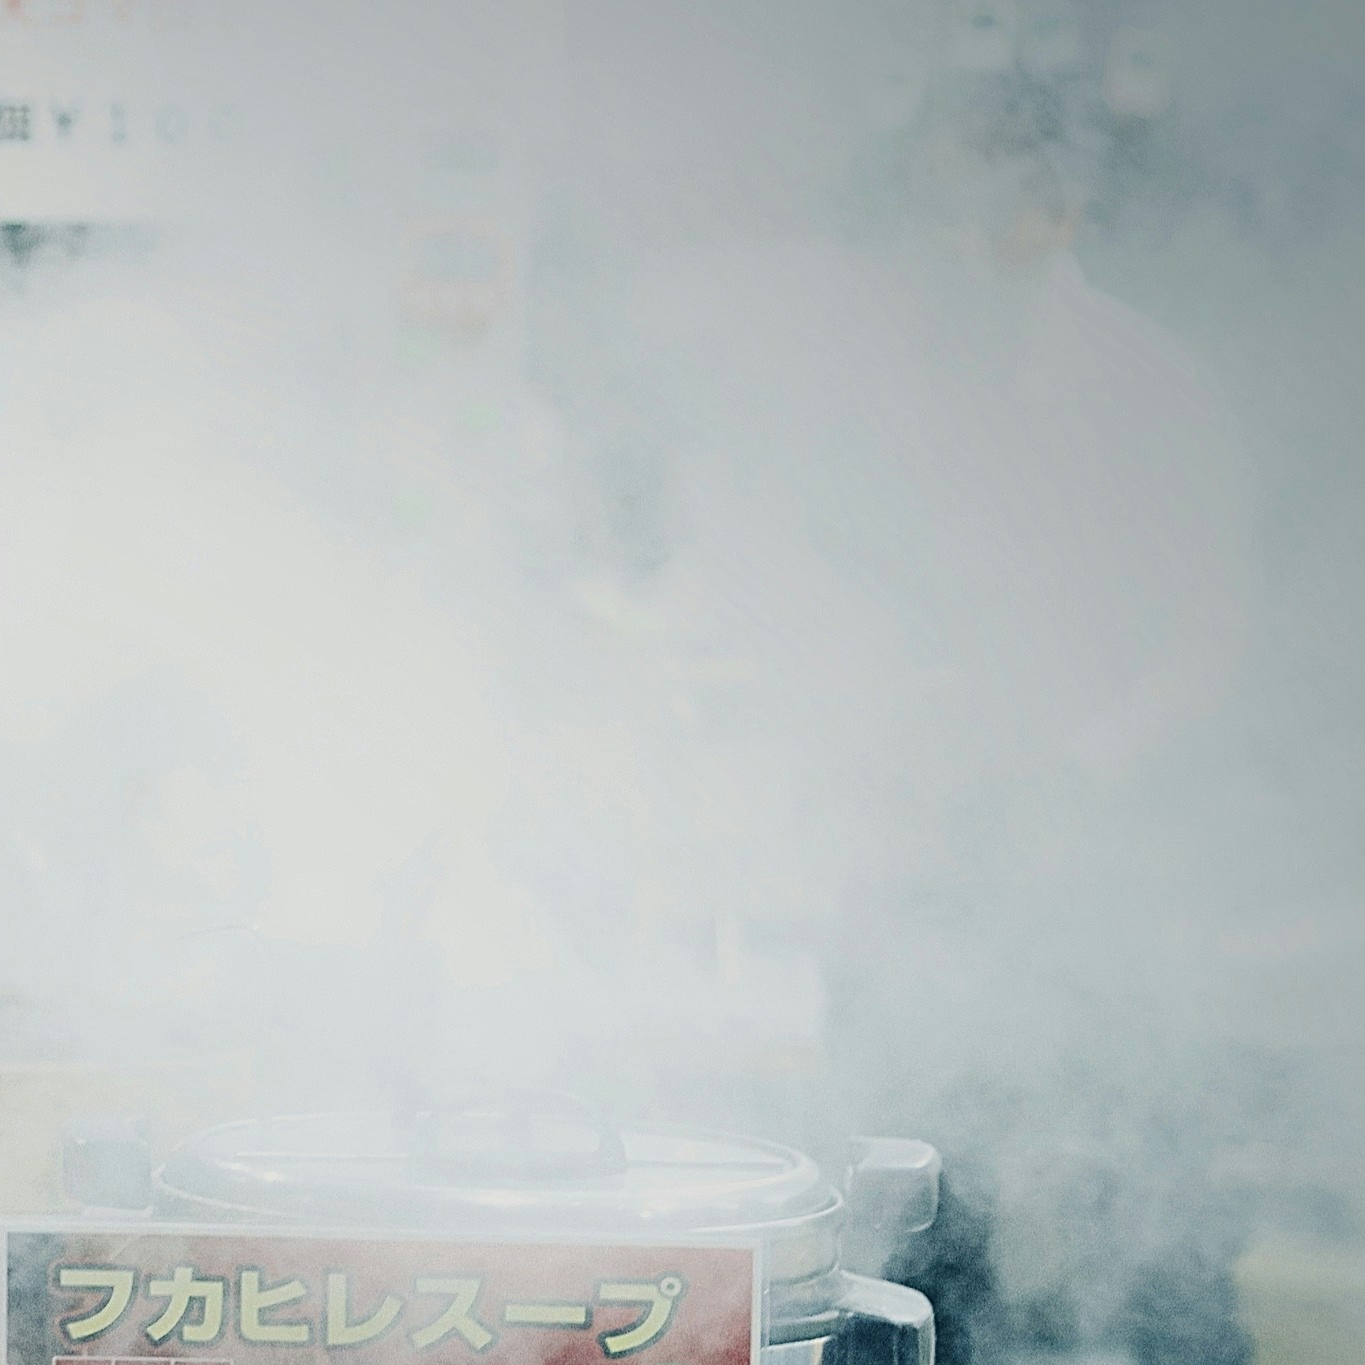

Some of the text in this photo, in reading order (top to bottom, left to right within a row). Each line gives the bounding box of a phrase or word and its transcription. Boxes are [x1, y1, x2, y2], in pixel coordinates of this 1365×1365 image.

[58, 1267, 684, 1356] フカヒレスープ
